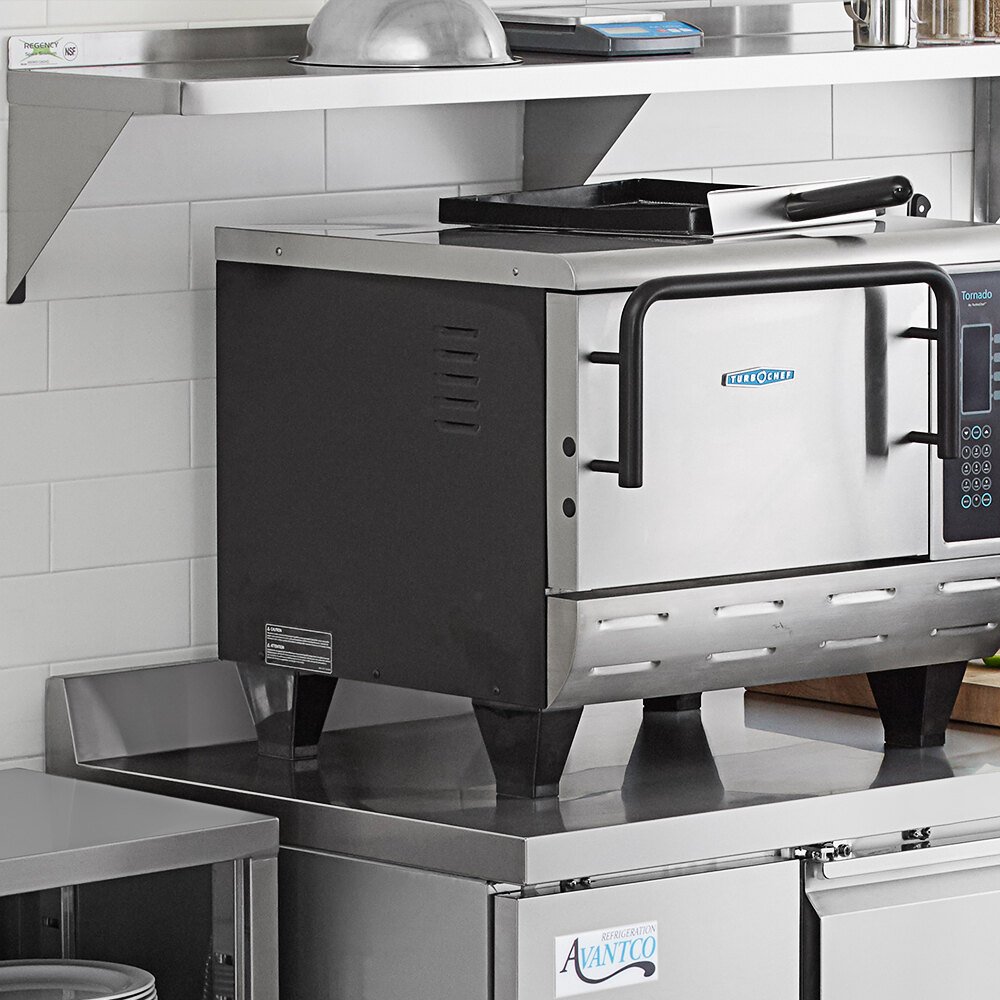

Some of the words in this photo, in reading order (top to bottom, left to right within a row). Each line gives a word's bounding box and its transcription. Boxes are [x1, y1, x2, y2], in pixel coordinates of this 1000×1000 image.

[23, 41, 59, 49] REGENCY
[961, 289, 993, 300] Tornado
[730, 370, 792, 384] TURBOCHEF
[601, 924, 656, 941] REFRIGERATION
[559, 936, 657, 984] AVANTCO
